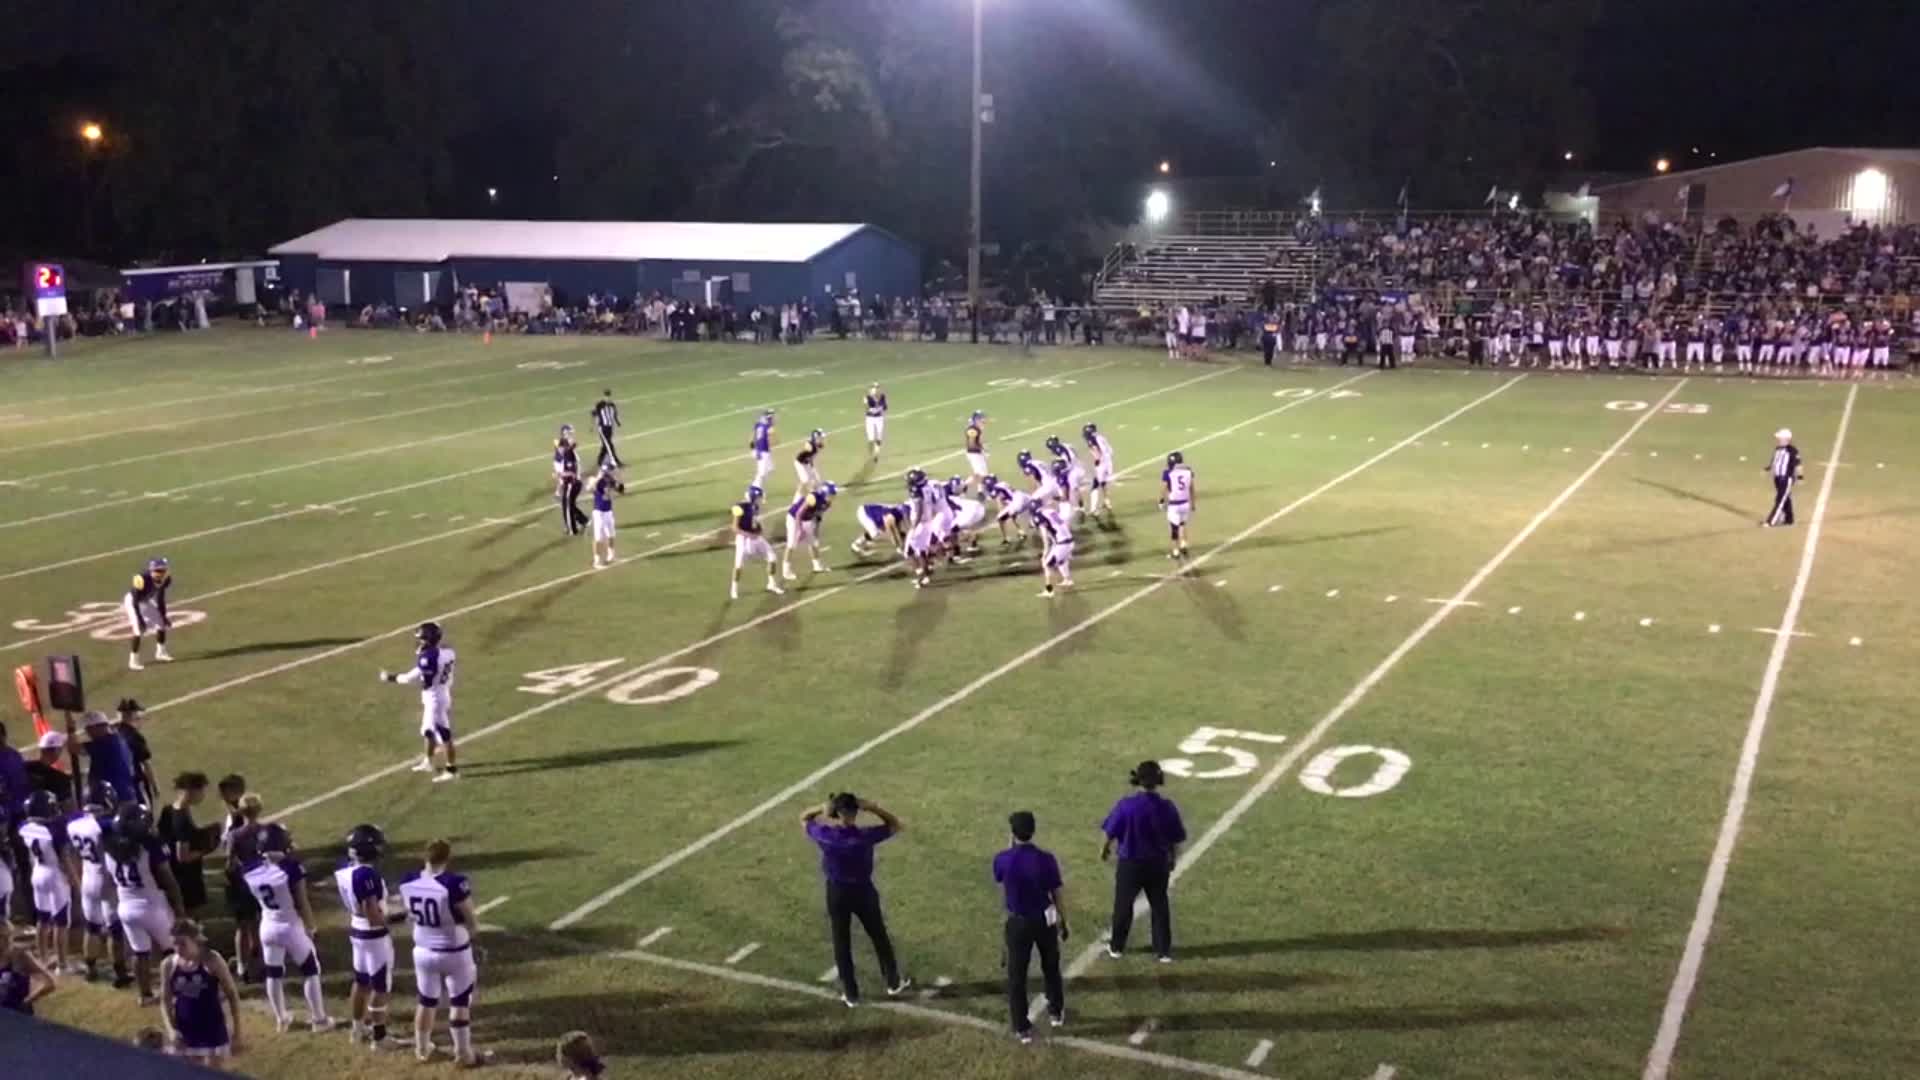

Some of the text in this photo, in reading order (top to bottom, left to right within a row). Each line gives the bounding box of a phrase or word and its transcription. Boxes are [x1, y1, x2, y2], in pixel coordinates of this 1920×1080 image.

[1177, 475, 1186, 491] 5
[1158, 726, 1412, 797] 50
[258, 883, 280, 911] 2
[408, 896, 442, 929] 50
